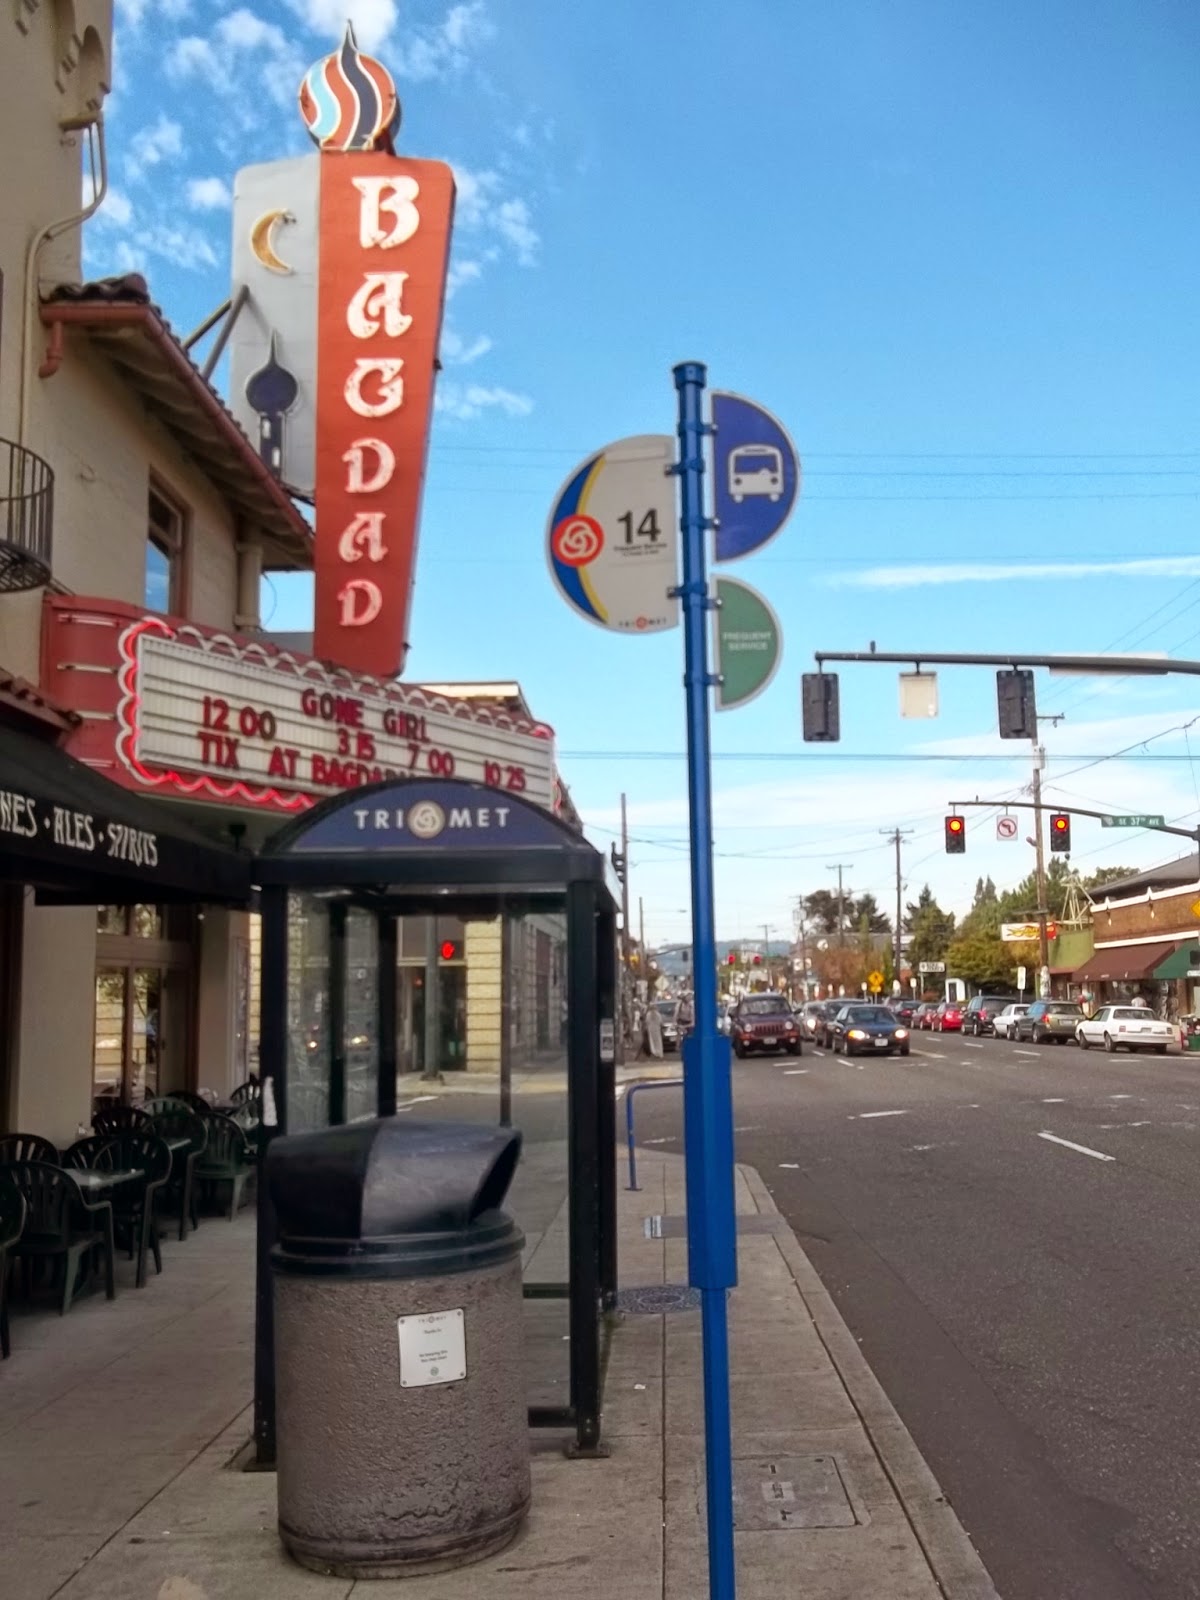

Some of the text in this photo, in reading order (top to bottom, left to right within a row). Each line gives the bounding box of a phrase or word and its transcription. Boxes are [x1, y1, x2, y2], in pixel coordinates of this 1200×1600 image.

[338, 175, 420, 627] BAGDAD
[616, 508, 661, 544] 14
[302, 689, 430, 744] GONE GIRL
[197, 730, 240, 770] TIX
[268, 746, 301, 780] AT
[53, 806, 95, 852] ALES
[107, 822, 159, 868] SPIRITS
[354, 807, 510, 830] TRI MET
